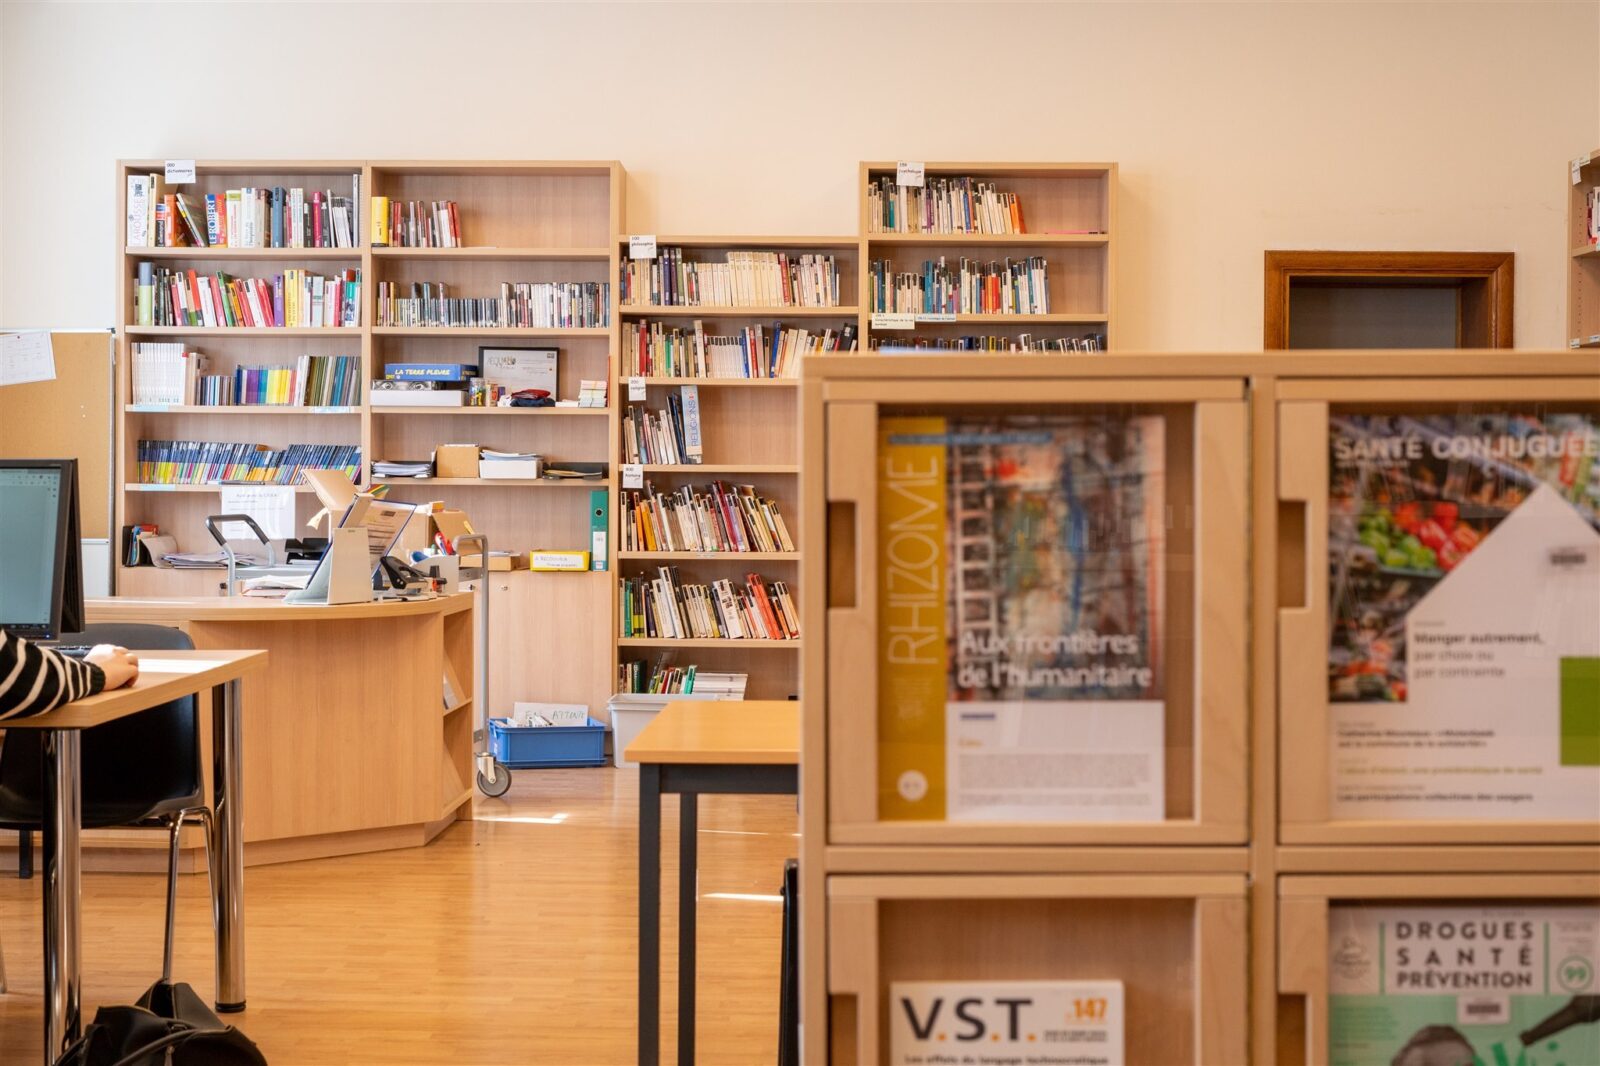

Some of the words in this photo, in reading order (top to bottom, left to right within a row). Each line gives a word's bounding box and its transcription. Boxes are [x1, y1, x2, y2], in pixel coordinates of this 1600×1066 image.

[405, 368, 425, 376] TERRE
[688, 400, 699, 447] RELIGIONS
[886, 455, 939, 665] RHIZOME
[959, 631, 1008, 655] Aux
[1016, 630, 1139, 655] frontières
[1413, 632, 1466, 646] Manger
[957, 665, 986, 688] de
[993, 665, 1153, 688] l'humanitaire
[1395, 921, 1535, 940] DROGUES
[1396, 942, 1532, 967] SANTÉ
[1396, 970, 1533, 989] PRÉVENTION
[1564, 966, 1588, 983] 99
[900, 997, 1038, 1042] V.S.T.
[1071, 997, 1109, 1020] 147
